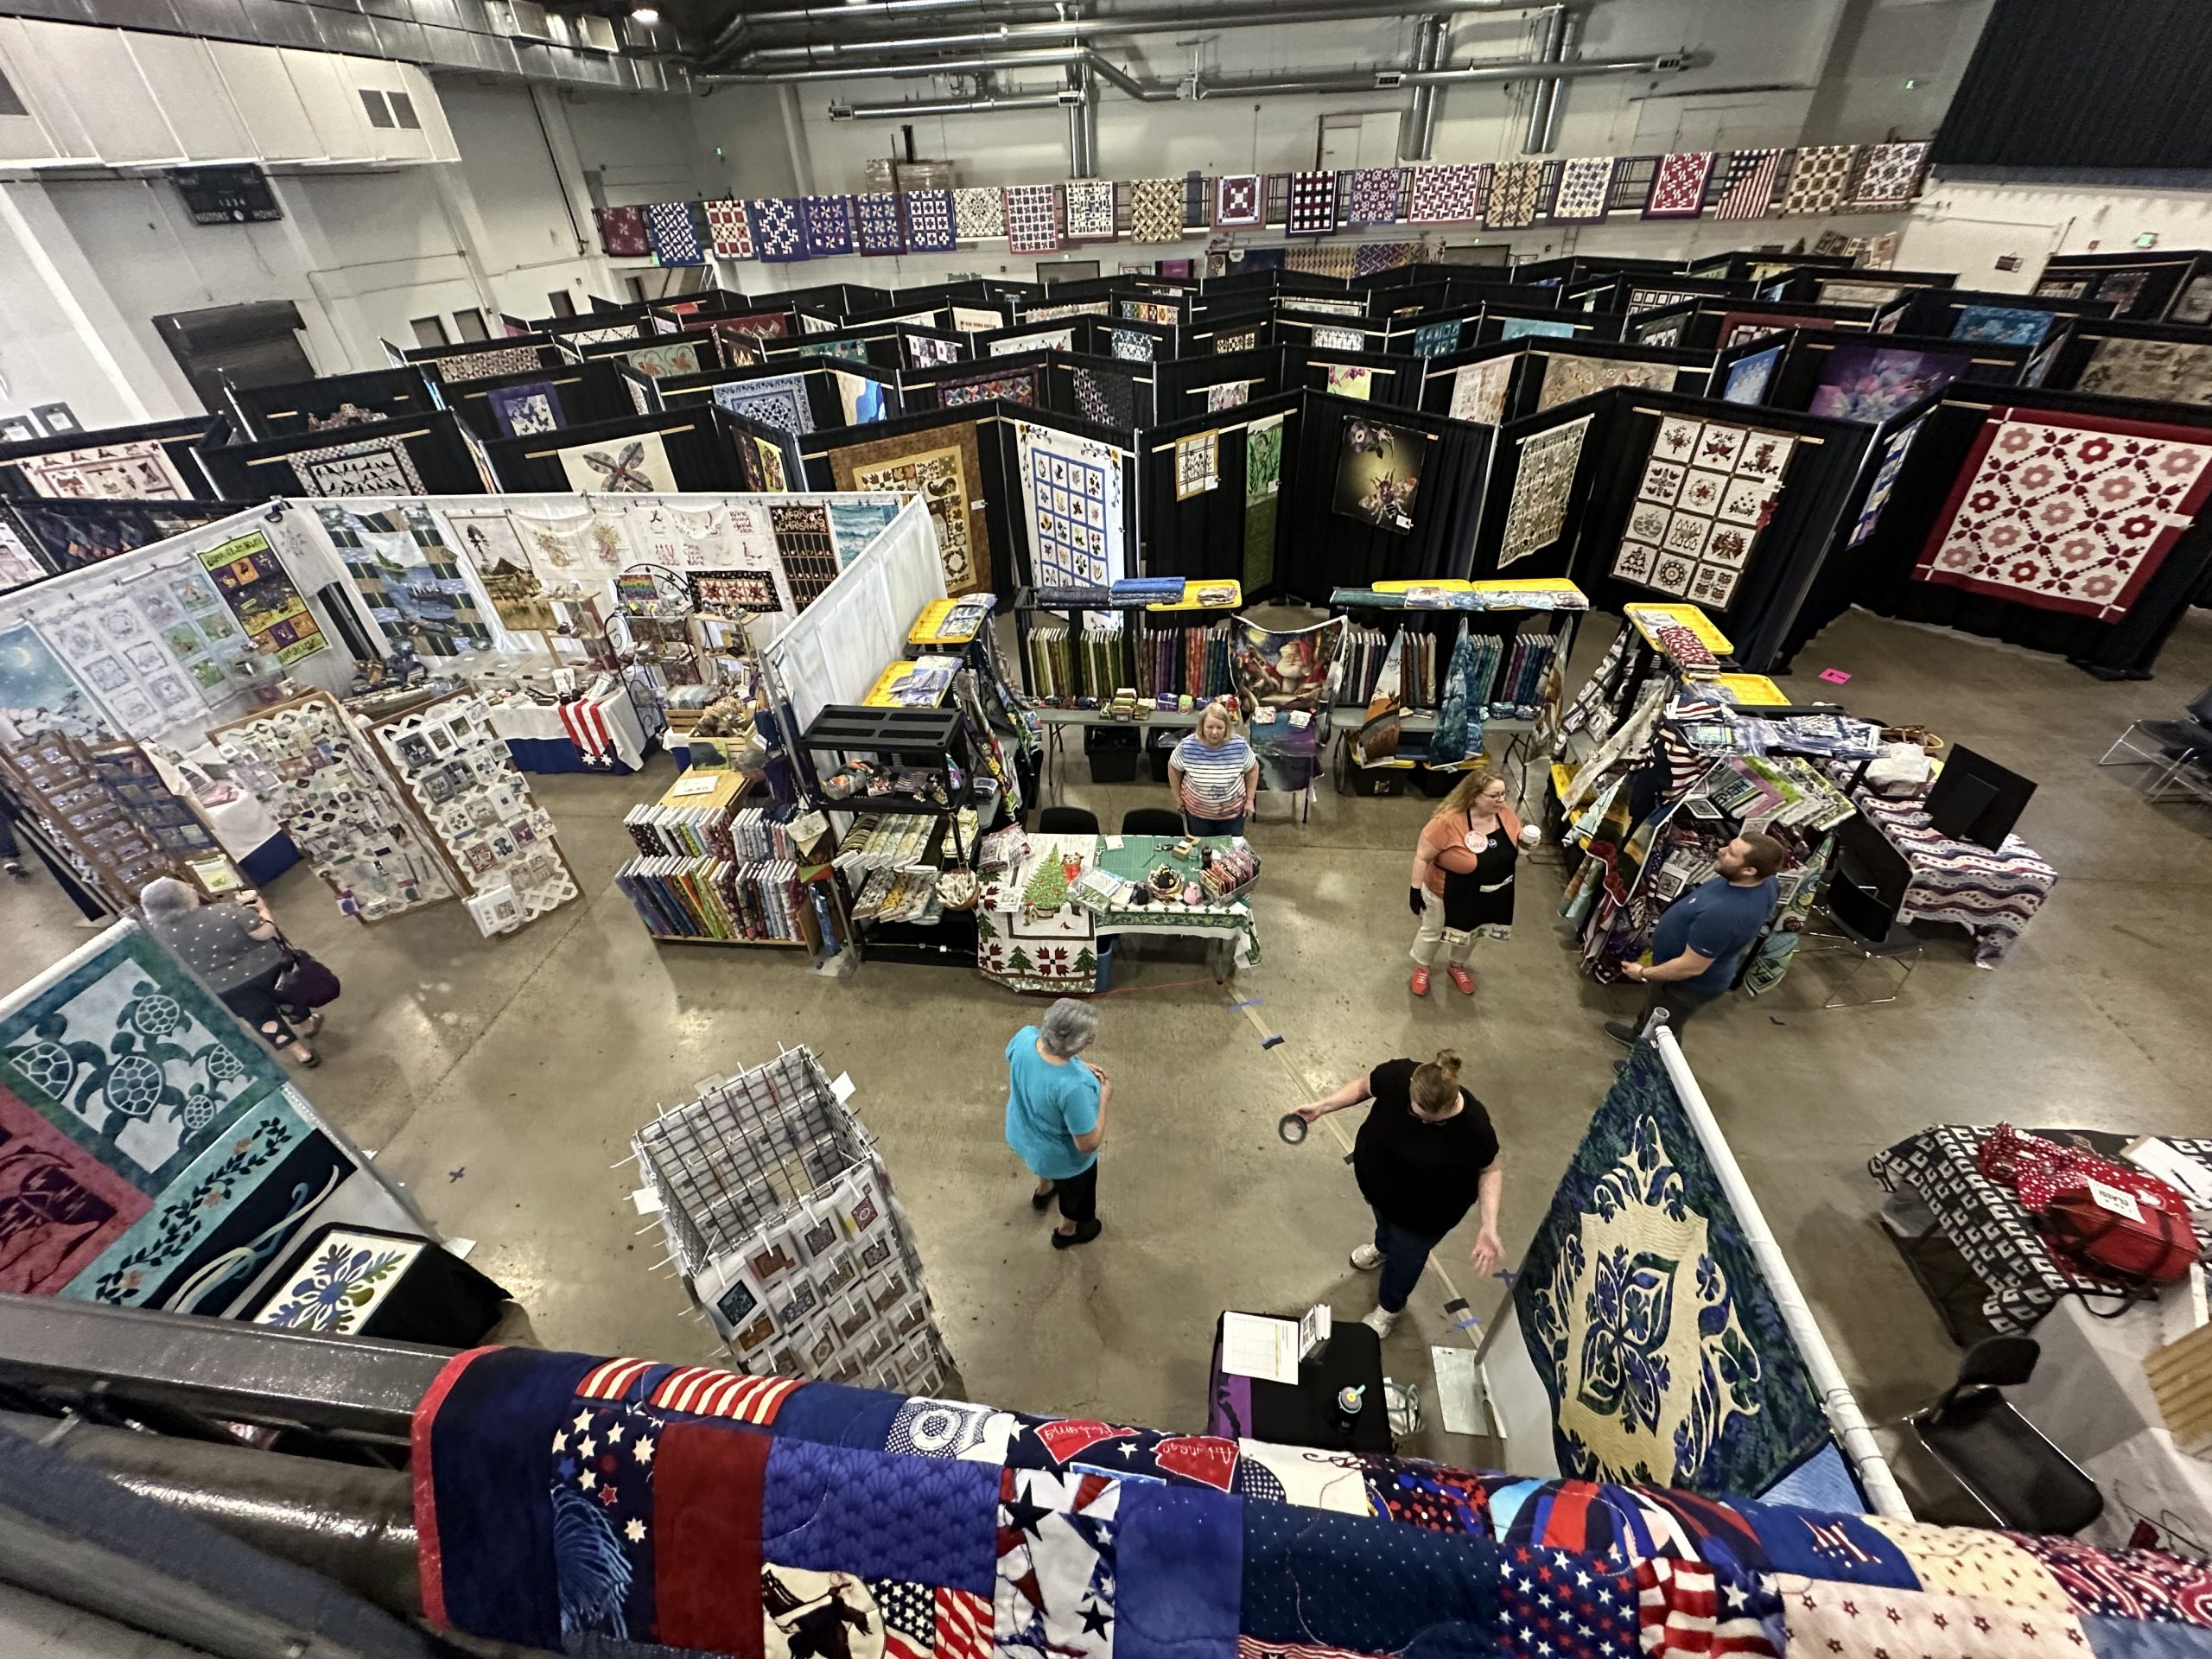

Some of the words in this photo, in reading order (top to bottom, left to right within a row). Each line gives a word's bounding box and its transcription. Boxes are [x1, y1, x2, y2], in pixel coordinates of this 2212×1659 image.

[195, 212, 231, 223] VISITORS
[252, 210, 280, 219] HOME
[781, 508, 810, 521] MERRY
[779, 516, 825, 531] CHRISTMAS
